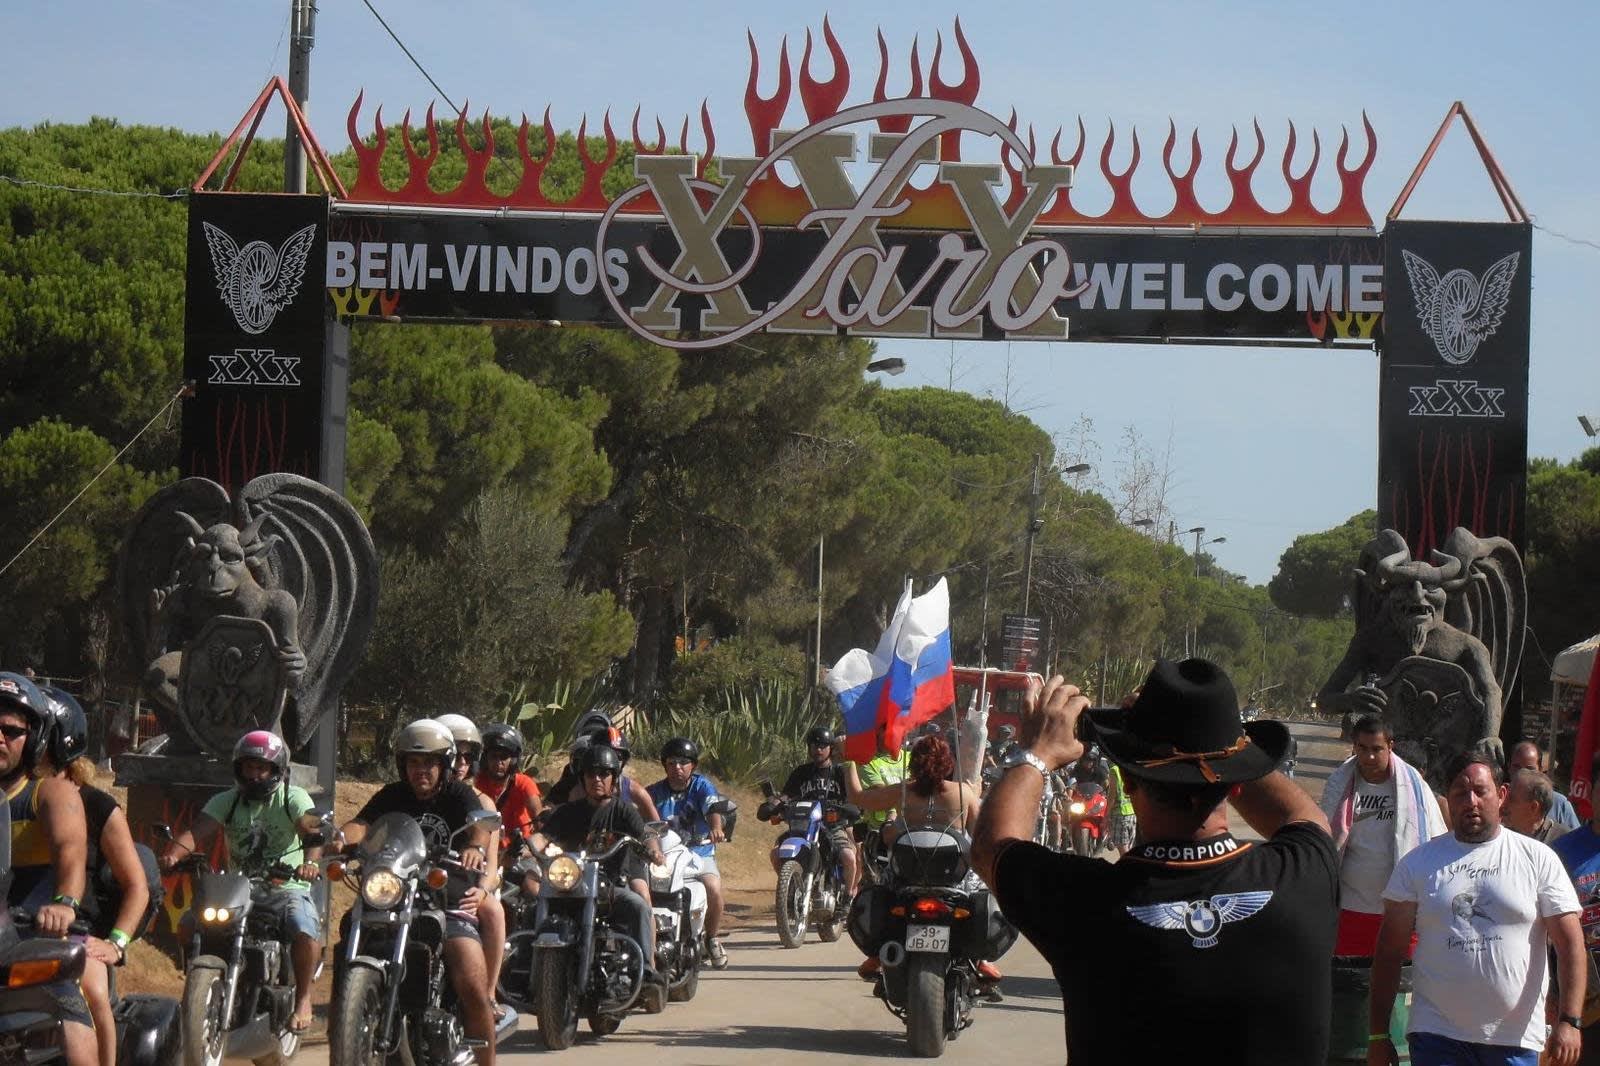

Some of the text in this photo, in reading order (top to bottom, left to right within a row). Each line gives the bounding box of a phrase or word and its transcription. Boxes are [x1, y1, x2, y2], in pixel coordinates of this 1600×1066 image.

[596, 97, 1091, 350] Faro
[325, 240, 630, 298] BEM-VINDOS
[1073, 262, 1384, 313] WELCOME
[1355, 794, 1391, 809] NIKE
[1375, 810, 1395, 821] AIR
[1143, 837, 1238, 861] SCORPION
[920, 926, 936, 938] 39
[908, 937, 947, 950] JB 07
